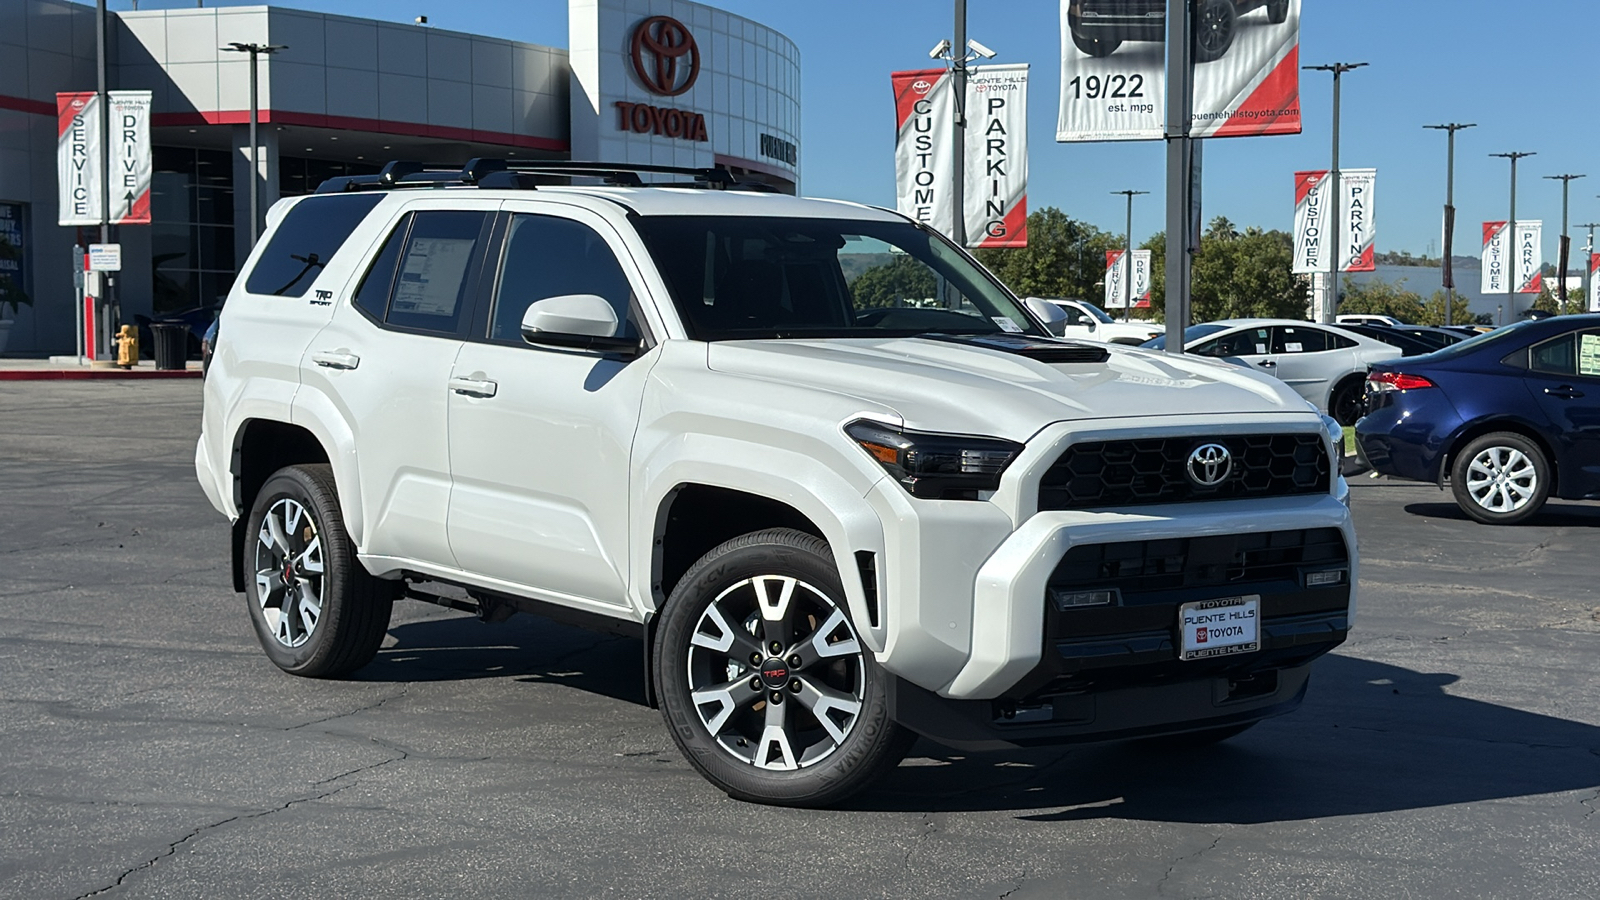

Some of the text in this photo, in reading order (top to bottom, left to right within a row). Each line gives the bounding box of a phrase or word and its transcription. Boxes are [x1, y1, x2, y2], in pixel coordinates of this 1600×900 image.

[1069, 73, 1144, 99] 19/22
[1107, 103, 1154, 114] est. mpg
[615, 101, 708, 142] TOYOTA
[73, 114, 136, 215] SERVICE DRIVE
[913, 98, 1007, 238] CUSTOME PARKING
[1305, 187, 1363, 267] CUSTOMER PARKING
[1490, 233, 1500, 290] CUSTOMER
[1522, 232, 1533, 289] PARKING
[1136, 260, 1144, 295] DRIVE
[315, 289, 333, 301] TRD
[1201, 597, 1242, 609] TOYOTA
[1184, 609, 1255, 626] PUENTE HILLS
[1208, 626, 1244, 639] TOYOTA
[1186, 642, 1256, 659] PUENTE HILLS
[763, 669, 786, 678] TRD
